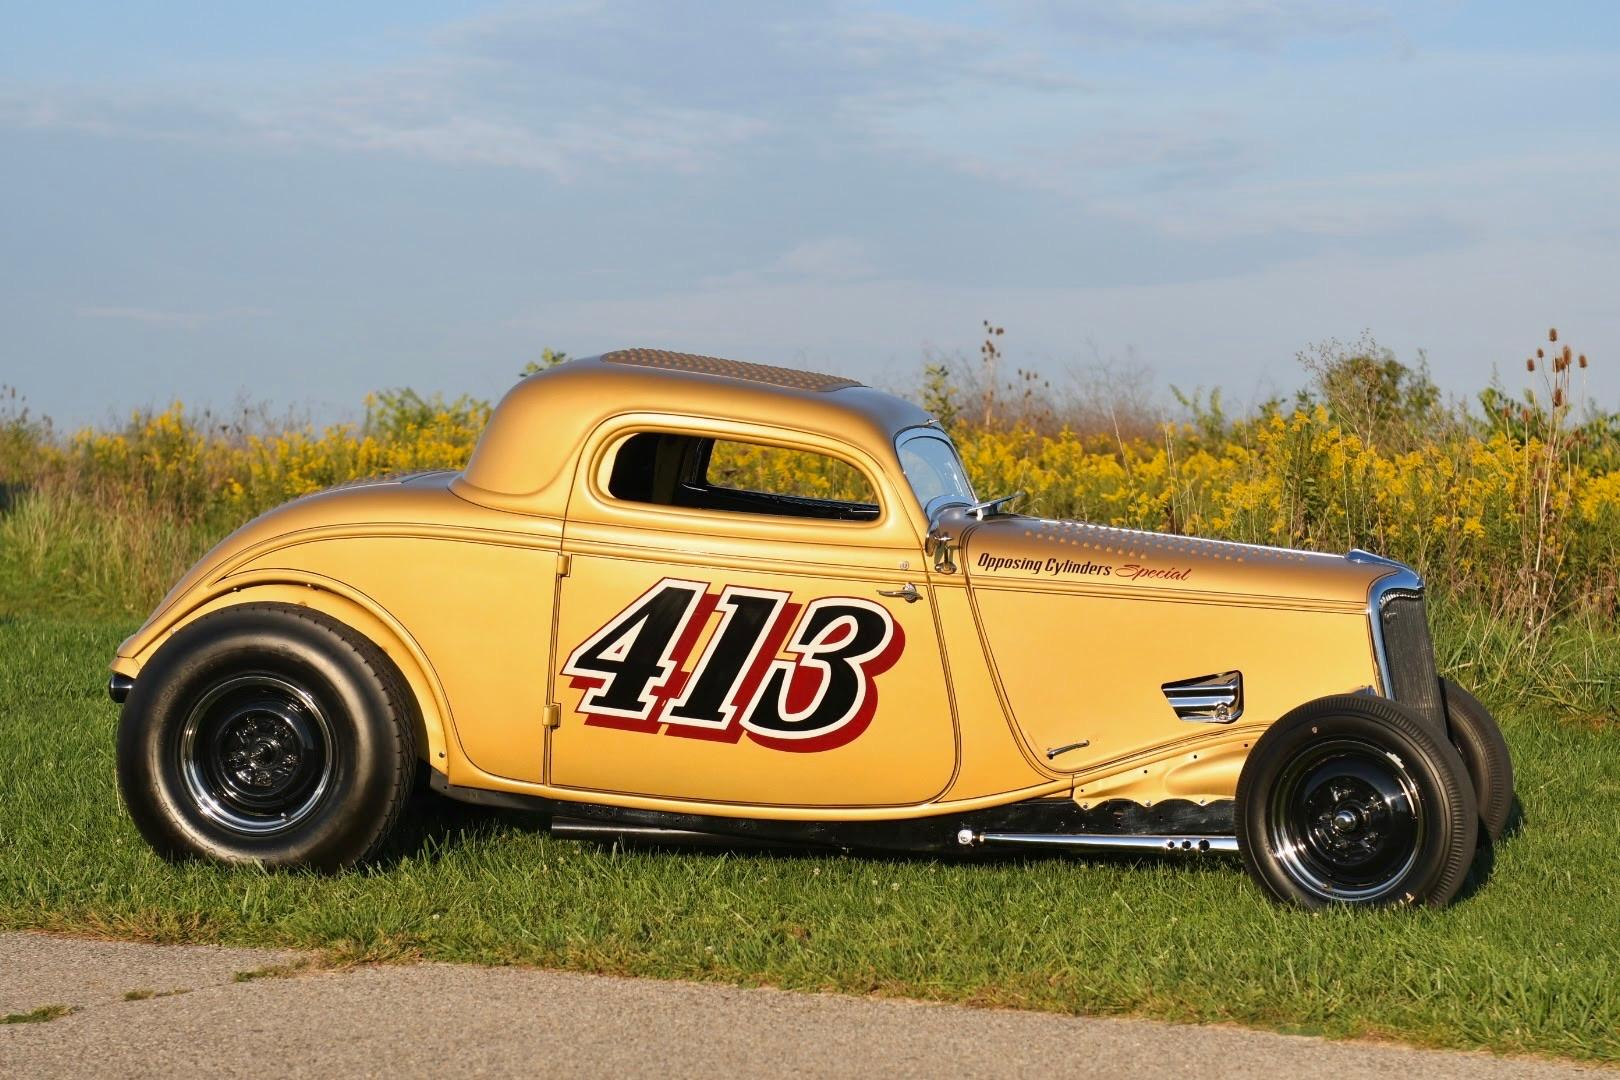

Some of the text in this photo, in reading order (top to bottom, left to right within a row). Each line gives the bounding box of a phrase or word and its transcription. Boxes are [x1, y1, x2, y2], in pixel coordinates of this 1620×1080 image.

[977, 552, 1192, 581] Opposing Cylinders Special
[560, 576, 904, 752] 413
